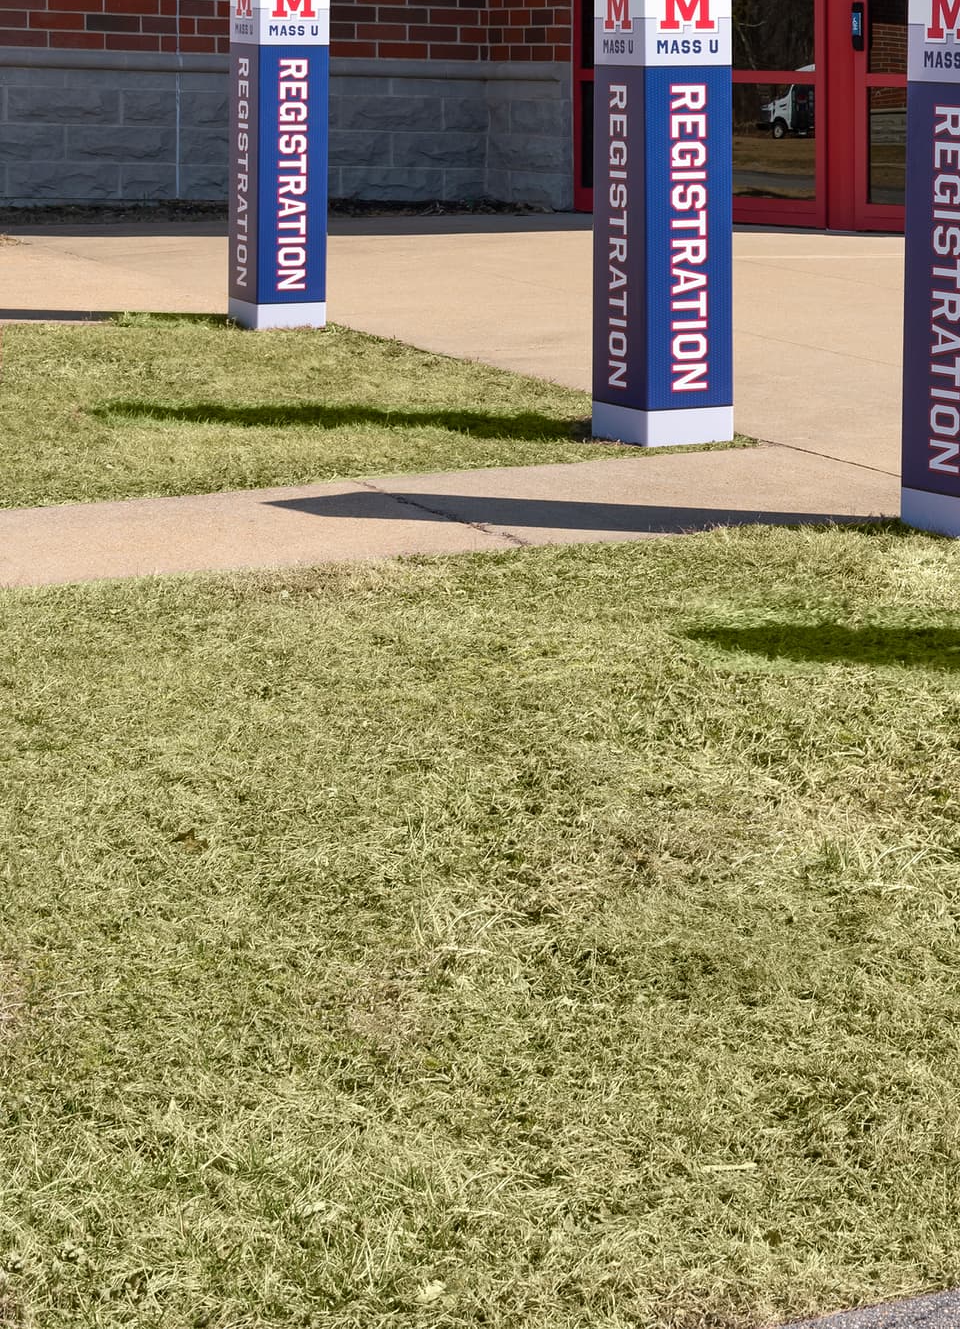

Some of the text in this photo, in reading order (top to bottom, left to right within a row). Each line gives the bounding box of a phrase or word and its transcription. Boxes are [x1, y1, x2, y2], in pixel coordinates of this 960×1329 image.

[269, 25, 319, 36] MASS U
[603, 39, 634, 54] MASS U
[656, 39, 719, 54] MASS U
[236, 57, 249, 287] REGISTRATION
[276, 58, 309, 291] REGISTRATION
[608, 83, 628, 388] REGISTRATION
[669, 82, 709, 392] REGISTRATION
